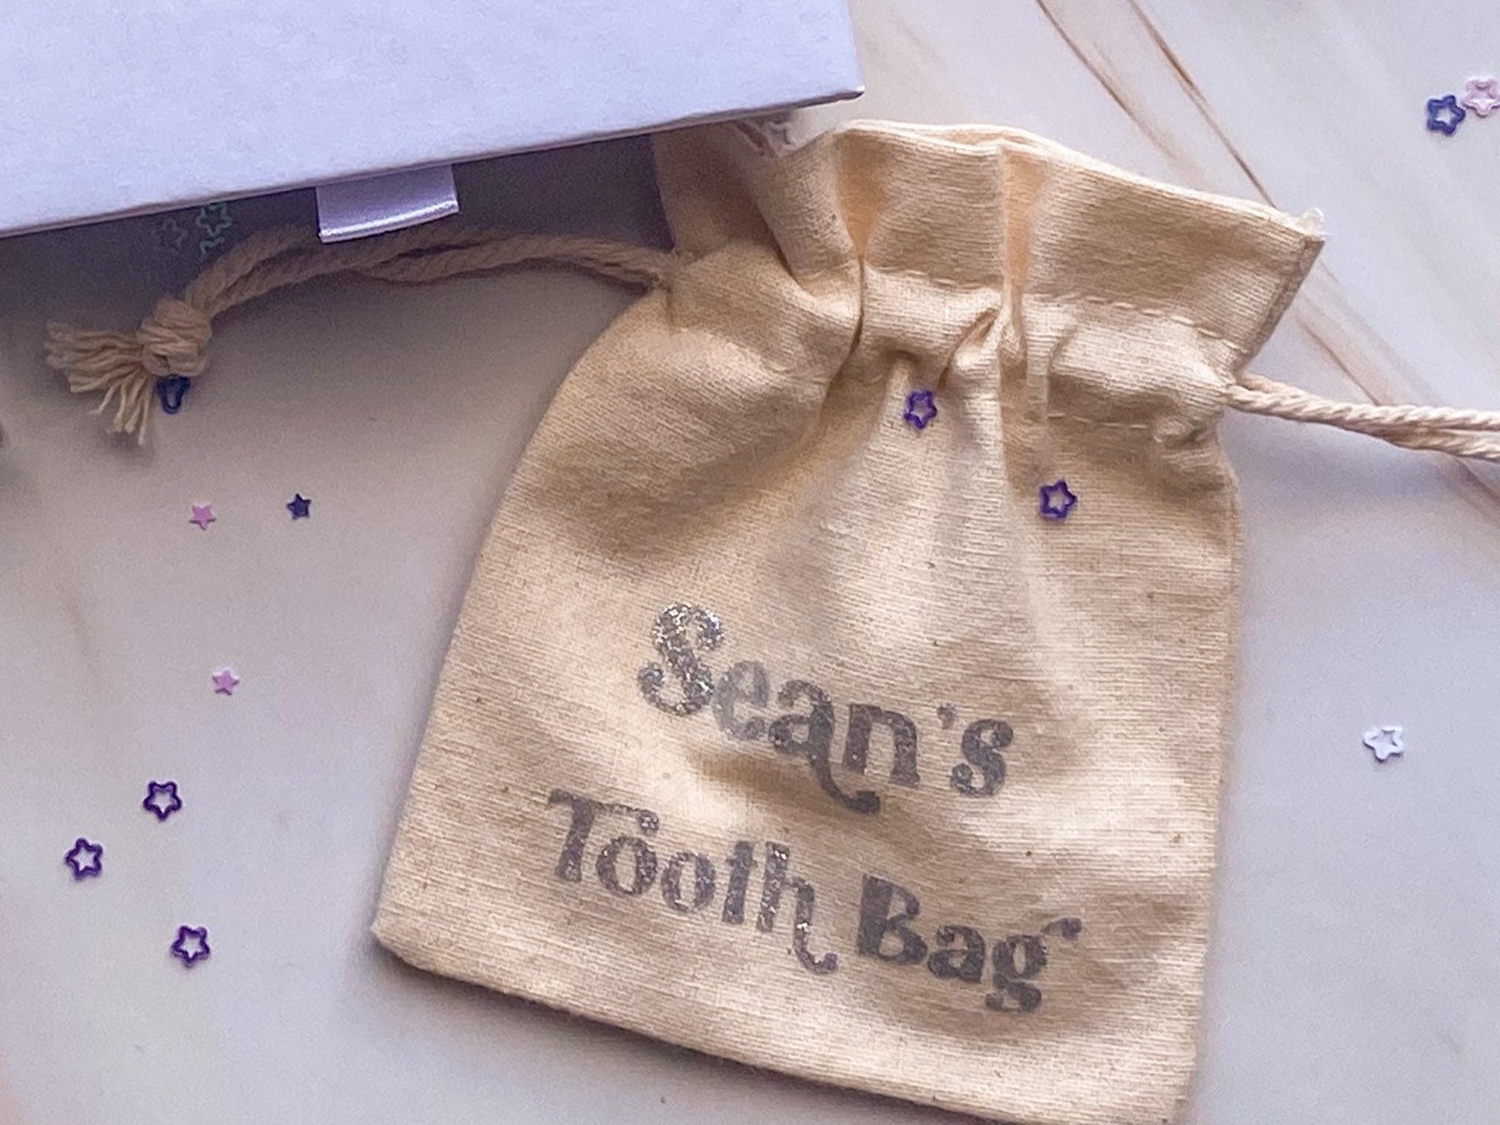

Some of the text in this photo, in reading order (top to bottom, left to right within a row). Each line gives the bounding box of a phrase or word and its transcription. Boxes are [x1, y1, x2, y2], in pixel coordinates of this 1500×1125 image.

[637, 601, 1014, 814] Sean's
[548, 789, 1083, 1013] Tooth Bag
